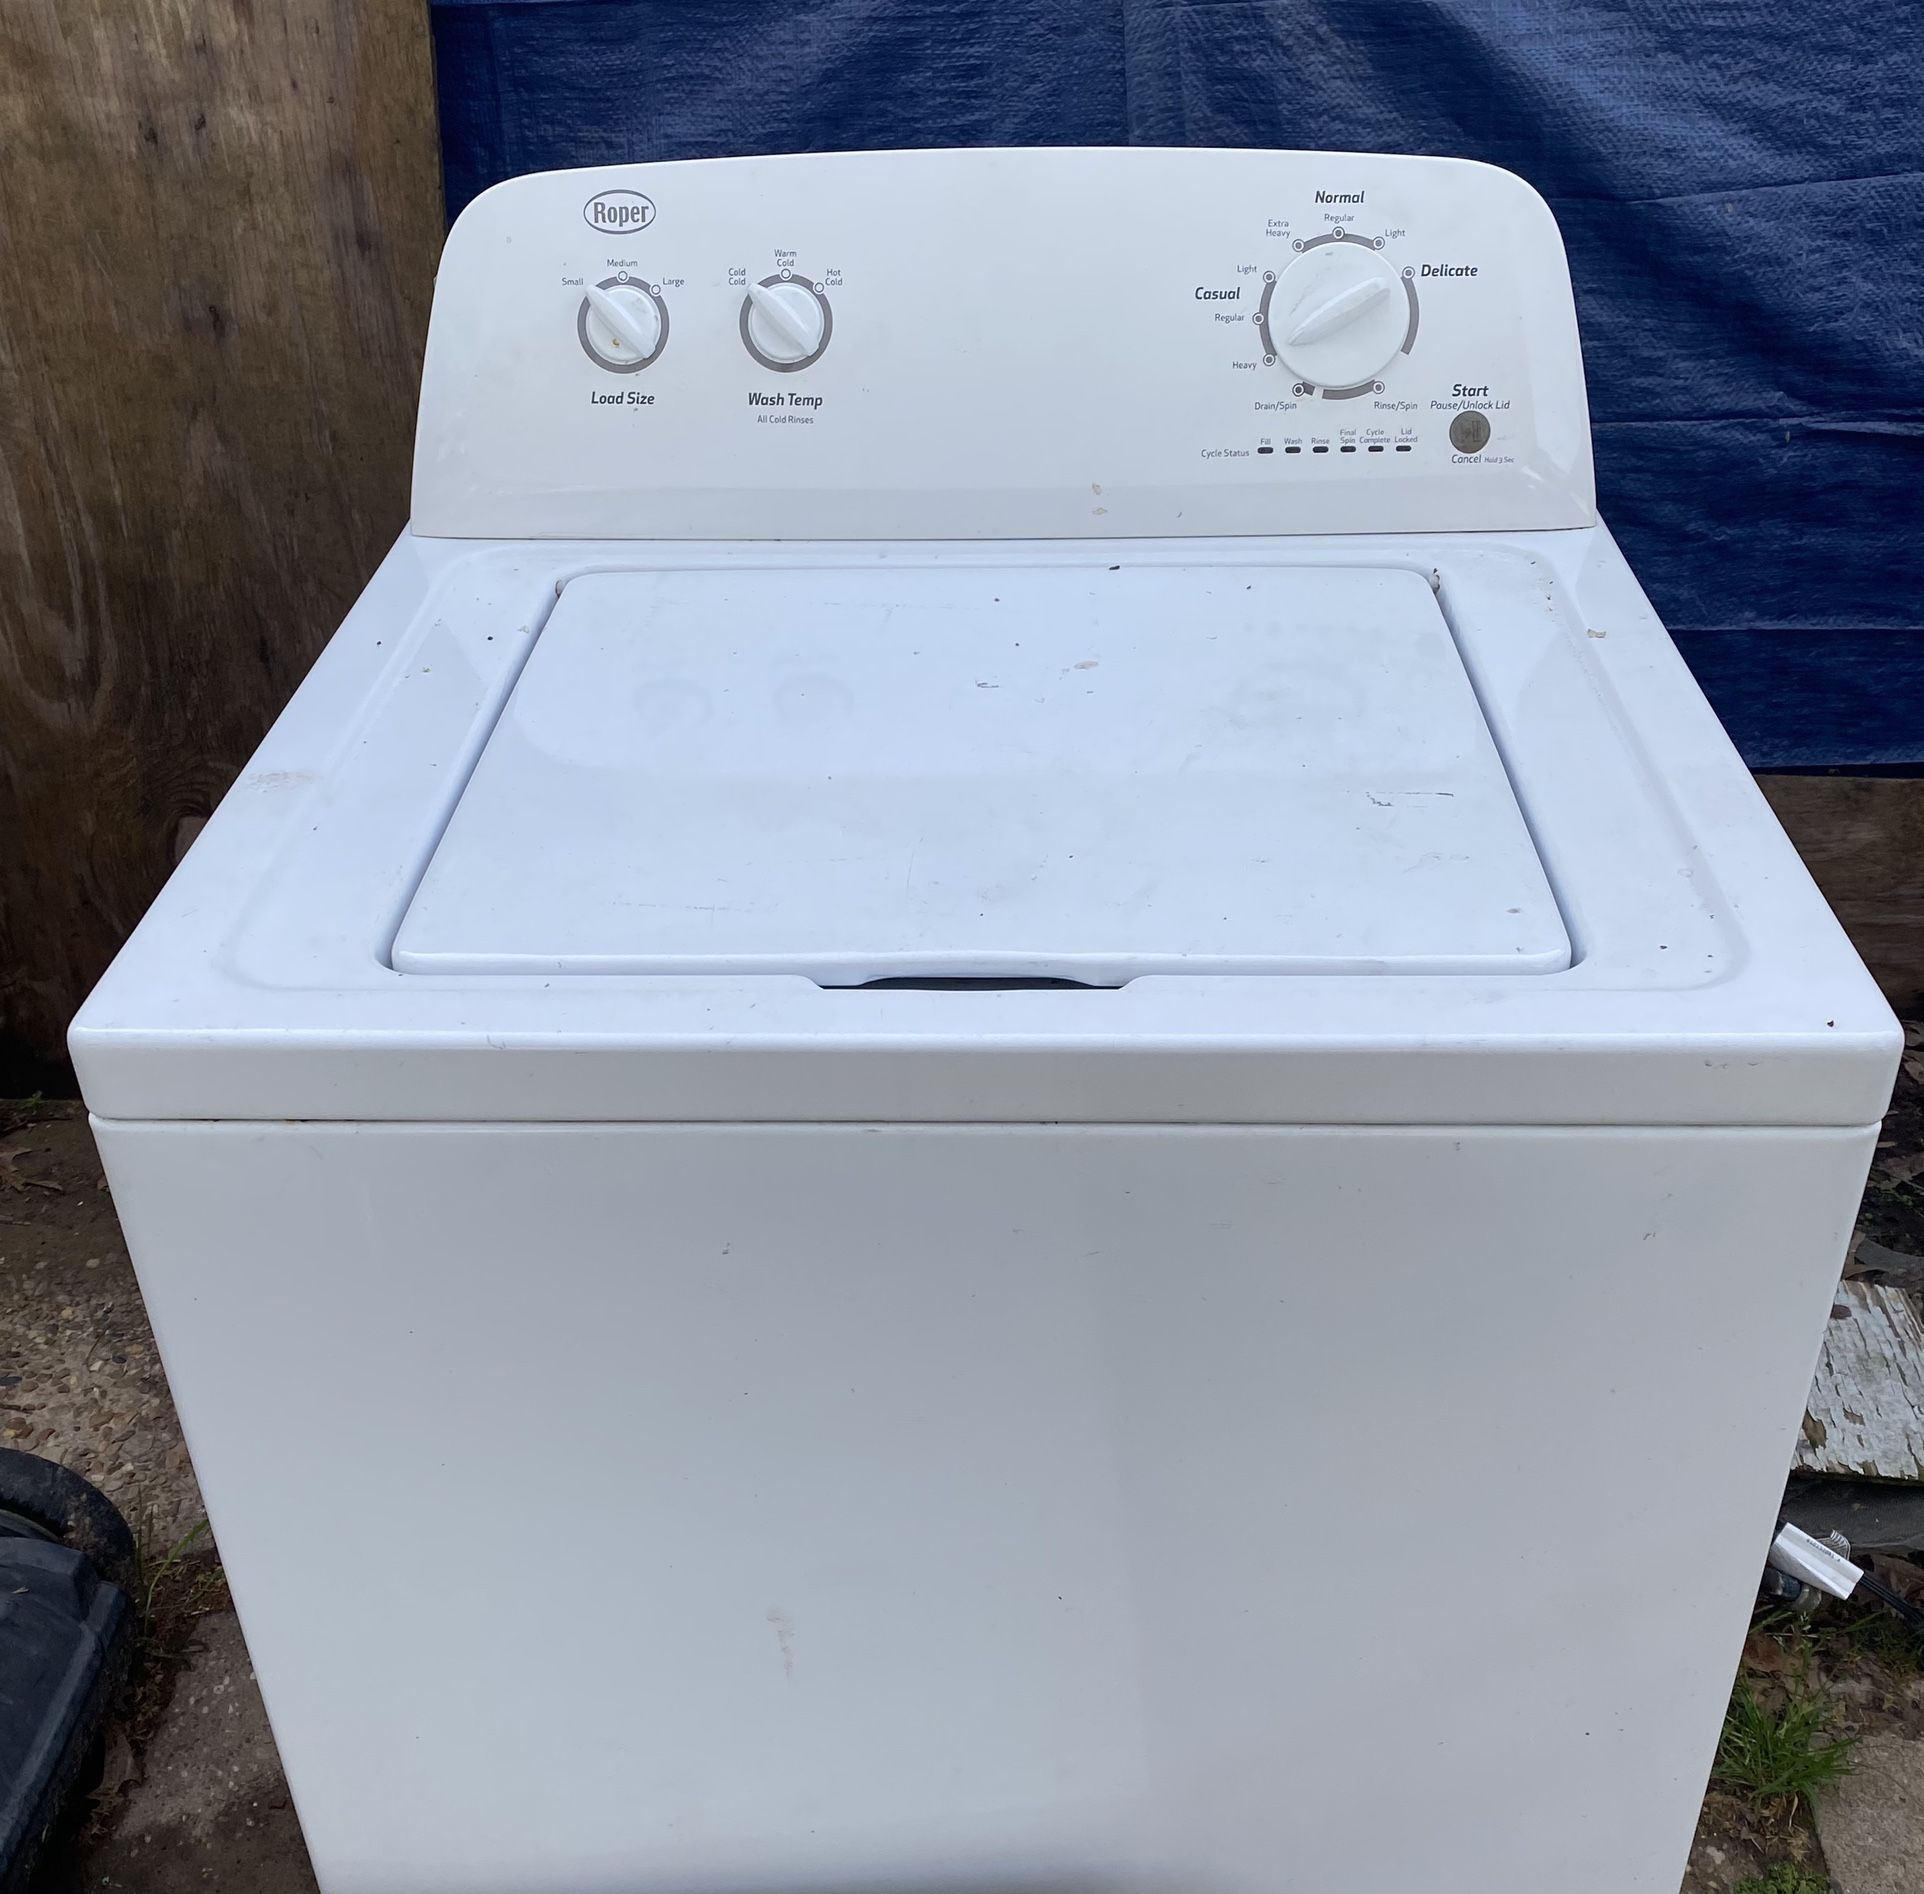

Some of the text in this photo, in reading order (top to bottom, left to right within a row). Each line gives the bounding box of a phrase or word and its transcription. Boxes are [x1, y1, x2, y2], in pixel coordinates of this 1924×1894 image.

[1315, 190, 1365, 204] Normal
[593, 201, 650, 227] Roper
[1324, 214, 1355, 223] Regular
[1268, 220, 1289, 228] Extra
[1265, 229, 1291, 238] Heavy
[1385, 229, 1406, 238] Light
[774, 249, 797, 258] Warm
[607, 259, 638, 268] Medium
[777, 259, 795, 267] Cold
[728, 268, 746, 277] Cold
[826, 268, 841, 277] Hot
[1237, 265, 1258, 275] Light
[1421, 264, 1479, 278] Delicate
[562, 277, 584, 286] Small
[662, 277, 685, 287] Large
[728, 277, 746, 286] Cold
[825, 278, 843, 286] Cold
[1195, 287, 1241, 301] Casual
[1215, 313, 1245, 324] Regular
[1232, 361, 1257, 371] Heavy
[1452, 384, 1489, 397] Start
[591, 391, 655, 405] Load Size
[749, 393, 823, 410] Wash Temp
[1254, 401, 1297, 411] Drain/Spin
[1374, 401, 1418, 411] Rinse/Spin
[1430, 400, 1511, 411] Pause/Unlock Lid
[757, 415, 814, 424] All Cold Rinses
[1366, 429, 1384, 437] Cycle
[1311, 437, 1330, 445] Rinse
[1340, 437, 1356, 445] Spin
[1359, 436, 1391, 445] Complete
[1394, 436, 1418, 444] Locked
[1201, 448, 1250, 459] Cycle Status
[1451, 454, 1482, 464] Cancel
